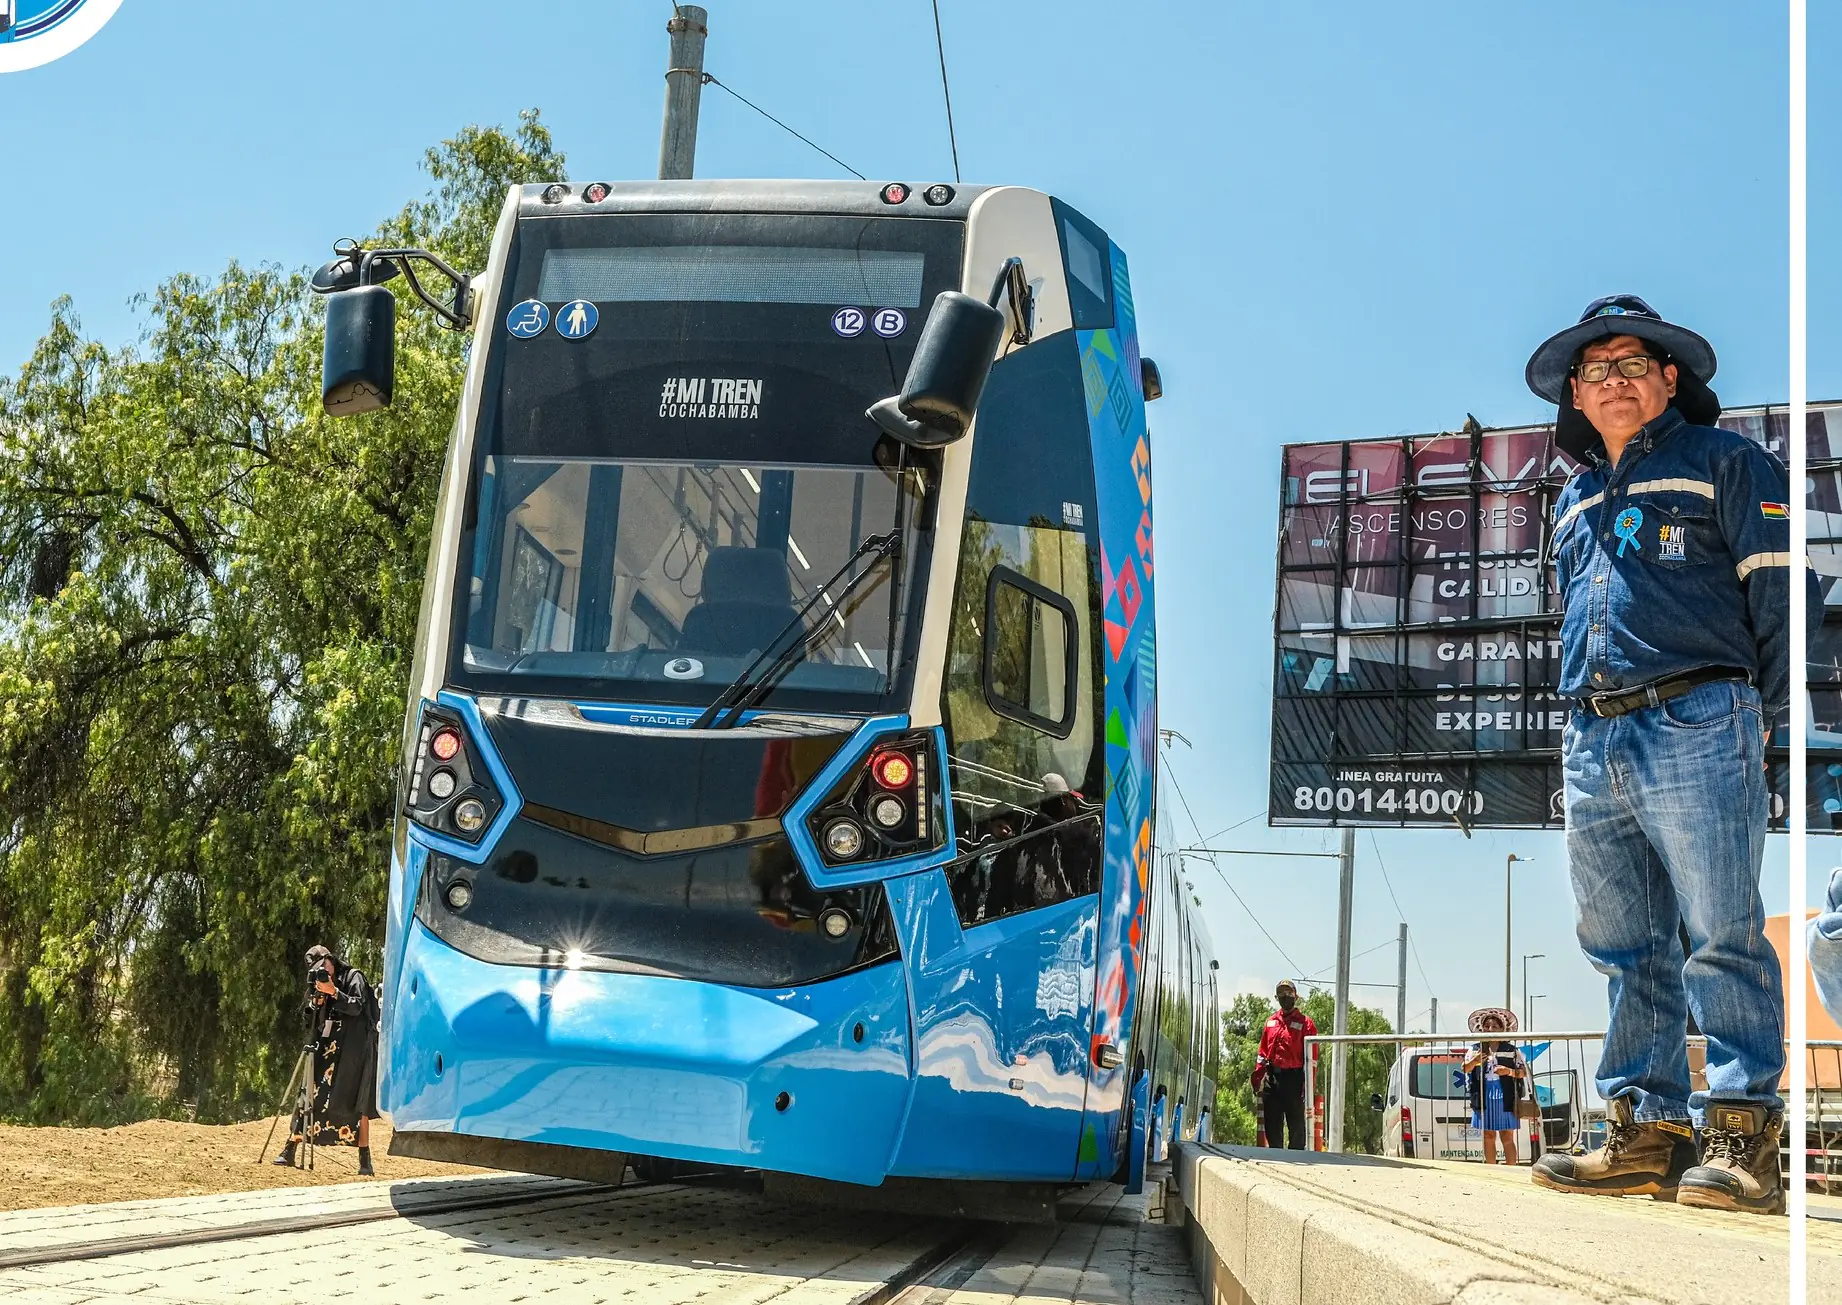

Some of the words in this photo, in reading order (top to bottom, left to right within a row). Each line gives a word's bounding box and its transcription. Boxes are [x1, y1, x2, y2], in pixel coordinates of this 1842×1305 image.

[836, 311, 861, 330] 12
[880, 312, 899, 331] B
[660, 378, 706, 404] #MI
[711, 378, 763, 405] TREN
[659, 403, 758, 419] COCHABAMBA
[1659, 525, 1685, 543] #MI
[1660, 542, 1685, 556] TREN
[1332, 771, 1372, 782] INEA
[1375, 772, 1444, 783] GRATUITA
